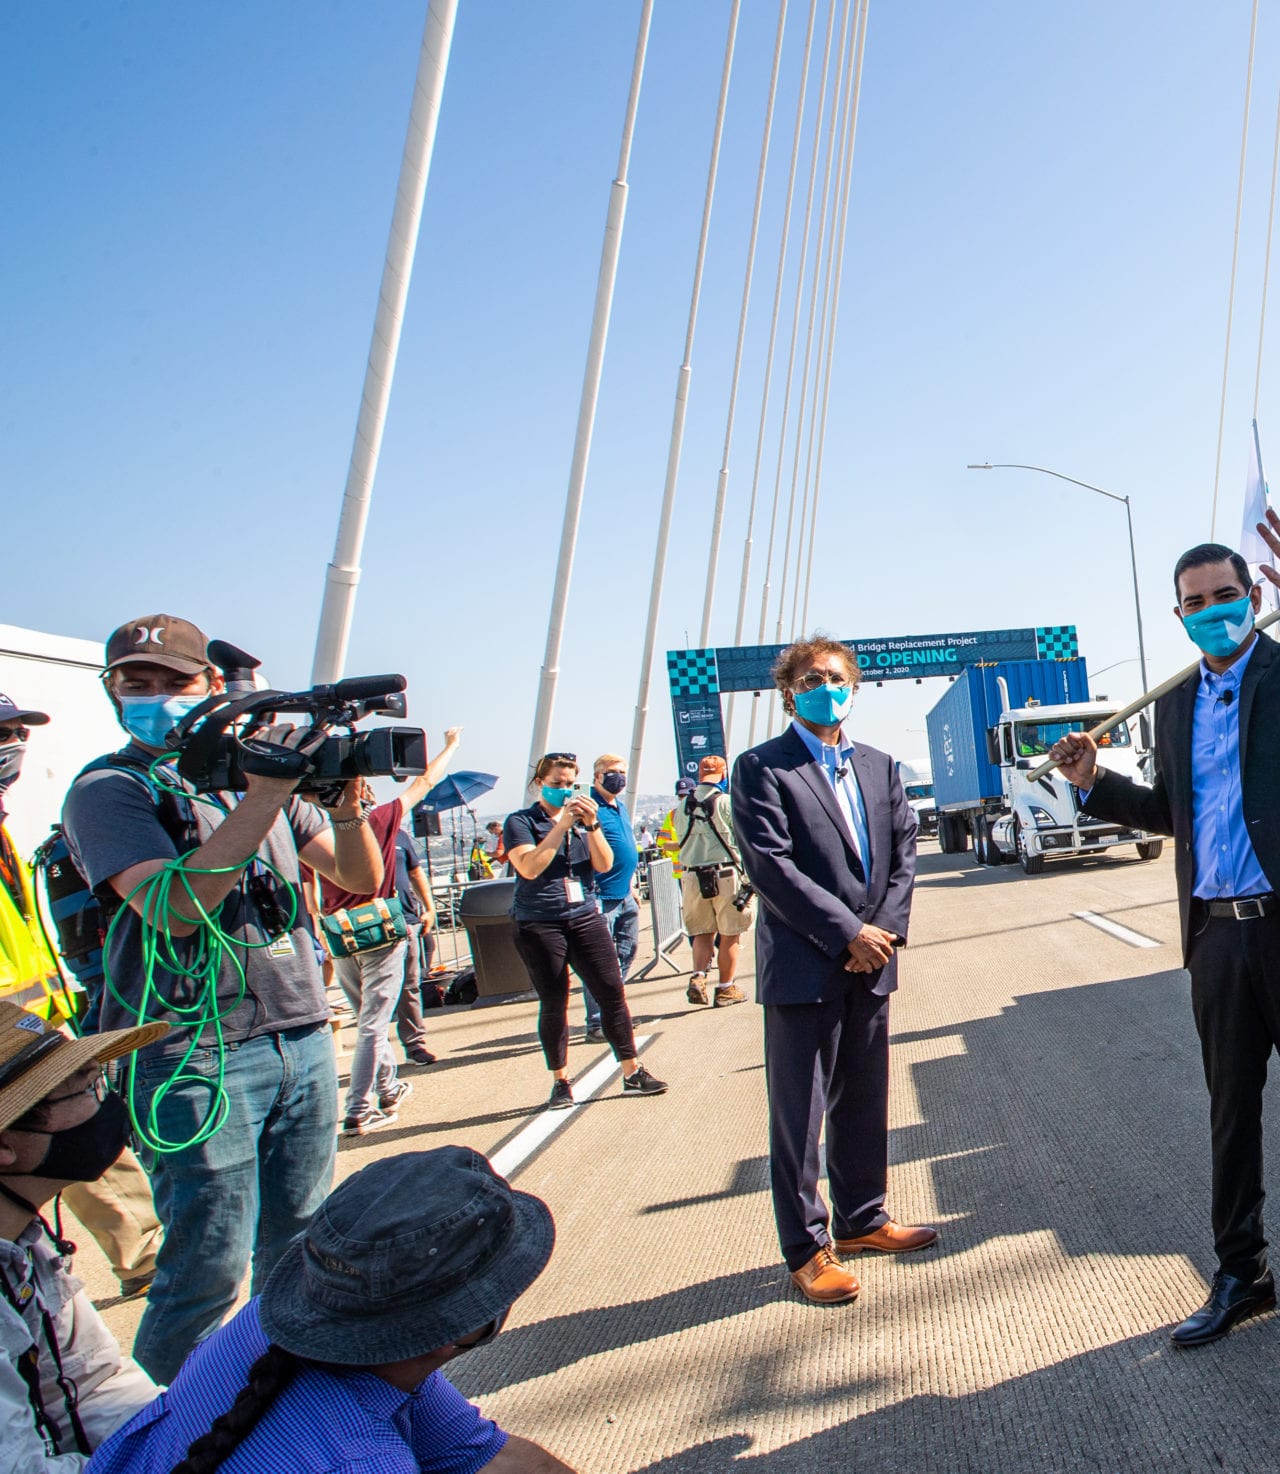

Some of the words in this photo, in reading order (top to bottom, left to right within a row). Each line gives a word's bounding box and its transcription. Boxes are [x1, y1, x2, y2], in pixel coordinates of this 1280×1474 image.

[858, 642, 887, 653] Bridge
[888, 639, 946, 651] Replacement
[947, 636, 978, 647] Project
[876, 648, 957, 667] OPENING
